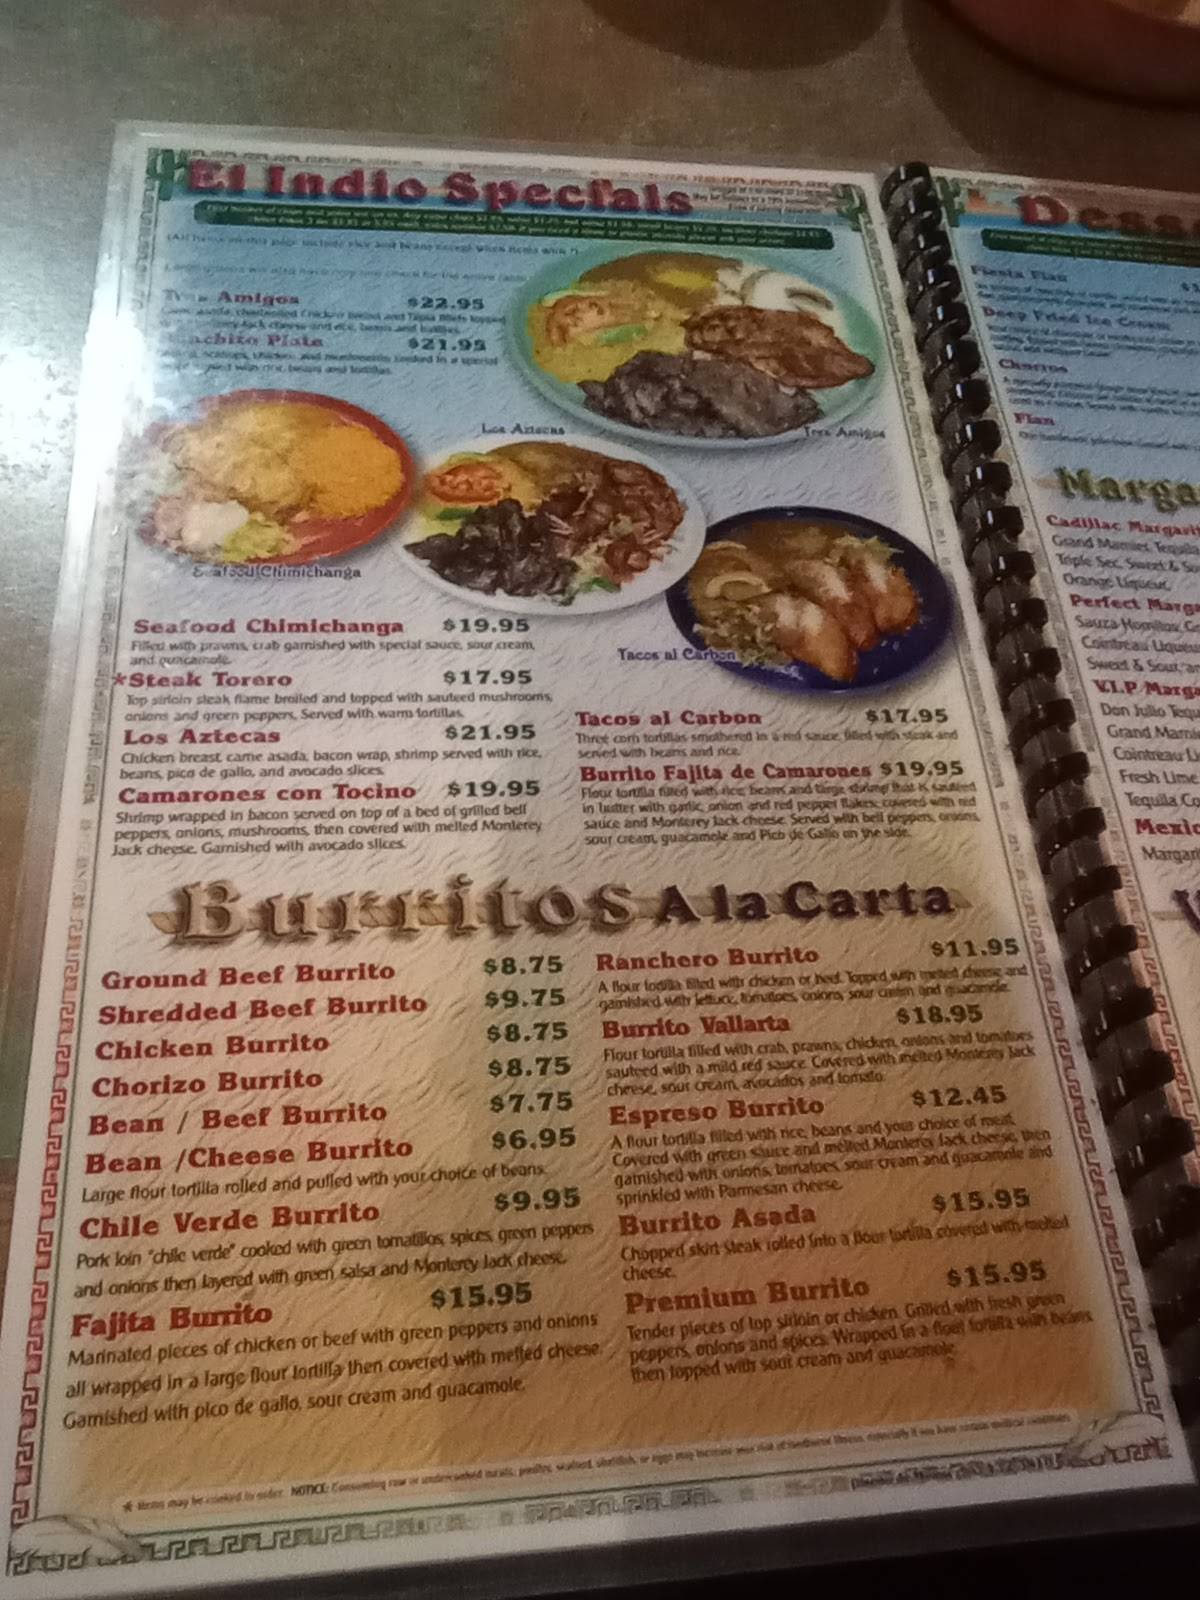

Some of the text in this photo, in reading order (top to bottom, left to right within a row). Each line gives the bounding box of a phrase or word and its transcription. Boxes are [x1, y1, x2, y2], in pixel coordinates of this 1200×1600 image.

[189, 159, 245, 191] El
[268, 167, 427, 197] Indio
[445, 172, 693, 214] Specials
[408, 297, 485, 311] $22.95
[408, 337, 487, 351] $21.95
[1014, 412, 1055, 426] Flan
[1046, 515, 1121, 531] Cadillac
[1063, 573, 1114, 589] Orange
[1070, 594, 1141, 610] Perfect
[134, 618, 530, 637] Seafood Chimichanga $19.95
[617, 648, 735, 661] Tacos al Carbon
[212, 672, 292, 687] Torero
[443, 669, 532, 685] $17.95
[575, 709, 948, 726] Tacos al Carbon $17.95
[1102, 703, 1130, 717] Don
[123, 724, 536, 745] Los Aztecas $21.95
[1107, 725, 1155, 738] Grand
[580, 760, 964, 784] Burrito Fajita de Camarones $19.95
[1120, 769, 1159, 784] Fresh
[118, 780, 540, 804] Camarones con Tocino $19.95
[116, 804, 526, 824] Shrimp wrapped in bacon served on top of a bed of grilled bell
[178, 872, 956, 944] Burritos A la Carta
[597, 938, 1019, 971] Ranchero Burrito $11.95
[102, 955, 563, 990] Ground Beef Burrito $8.75
[98, 988, 565, 1025] Shredded Beef Burrito $9.75
[603, 1004, 983, 1039] Burrito Vallarta $18.95
[95, 1022, 569, 1060] Chicken Burrito $8.75
[92, 1056, 572, 1097] Chorizo Burrito $8.75
[88, 1115, 165, 1136] Bean
[202, 1106, 271, 1130] Beef
[282, 1102, 387, 1126] Burrito
[490, 1091, 573, 1113] $7.75
[608, 1085, 1007, 1129] Espreso Burrito $12.45
[85, 1153, 162, 1175] Bean
[307, 1137, 413, 1162] Burrito
[492, 1127, 576, 1150] $6.95
[82, 1187, 125, 1204] Large
[130, 1186, 166, 1199] flour
[172, 1182, 219, 1197] tortilla
[225, 1178, 267, 1194] rolled
[272, 1177, 301, 1191] and
[306, 1172, 352, 1189] pulled
[358, 1169, 388, 1186] with
[393, 1168, 425, 1188] your
[430, 1167, 477, 1183] choice
[483, 1165, 498, 1179] of
[617, 1190, 681, 1208] sprinkled
[684, 1188, 714, 1201] with
[719, 1182, 788, 1198] Parmesan
[79, 1187, 581, 1239] Chile Verde Burrito $9.95
[618, 1188, 1031, 1236] Burrito Asada $15.95
[625, 1259, 1047, 1315] Premium Burrito $15.95
[71, 1281, 533, 1340] Fajita Burrito $15.95
[68, 1313, 598, 1367] Marinated pieces of chicken or beef with green peppers and onions
